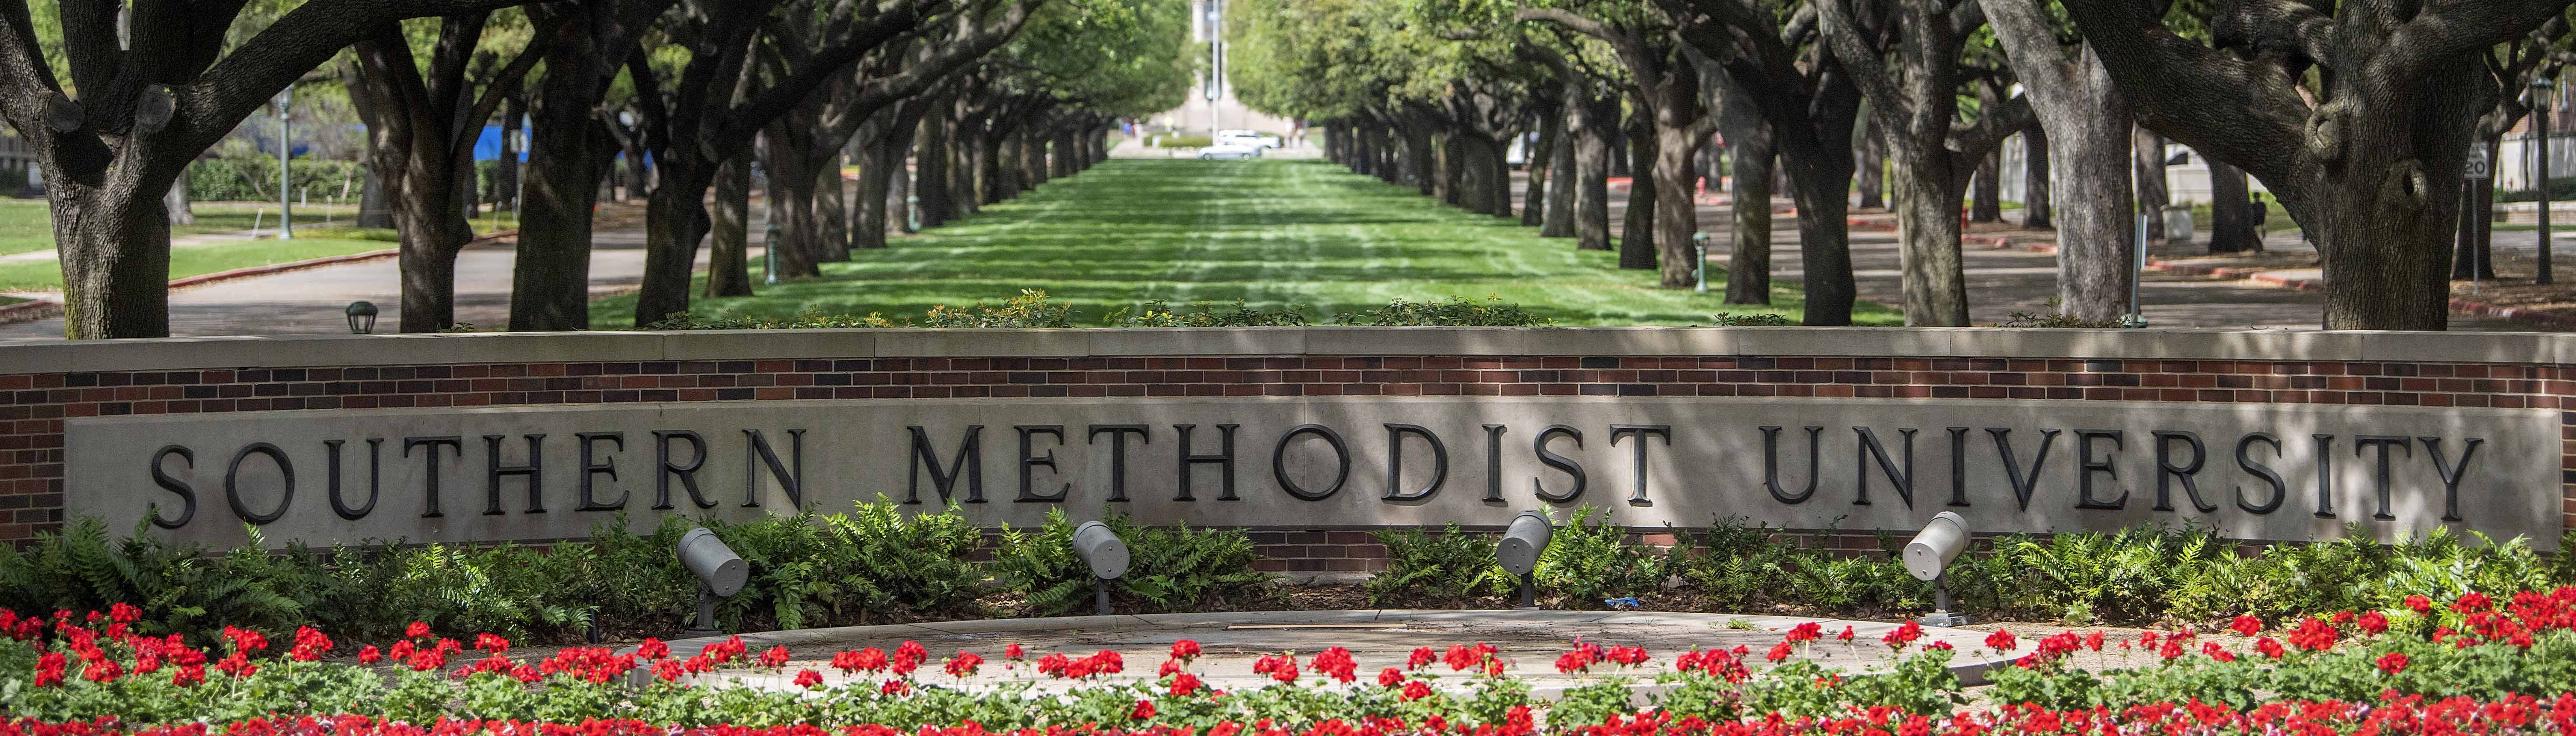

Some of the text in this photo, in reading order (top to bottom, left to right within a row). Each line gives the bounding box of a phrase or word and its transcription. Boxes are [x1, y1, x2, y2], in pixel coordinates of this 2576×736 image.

[151, 423, 2484, 529] SOUTHERN METHODIST UNIVERSITY
